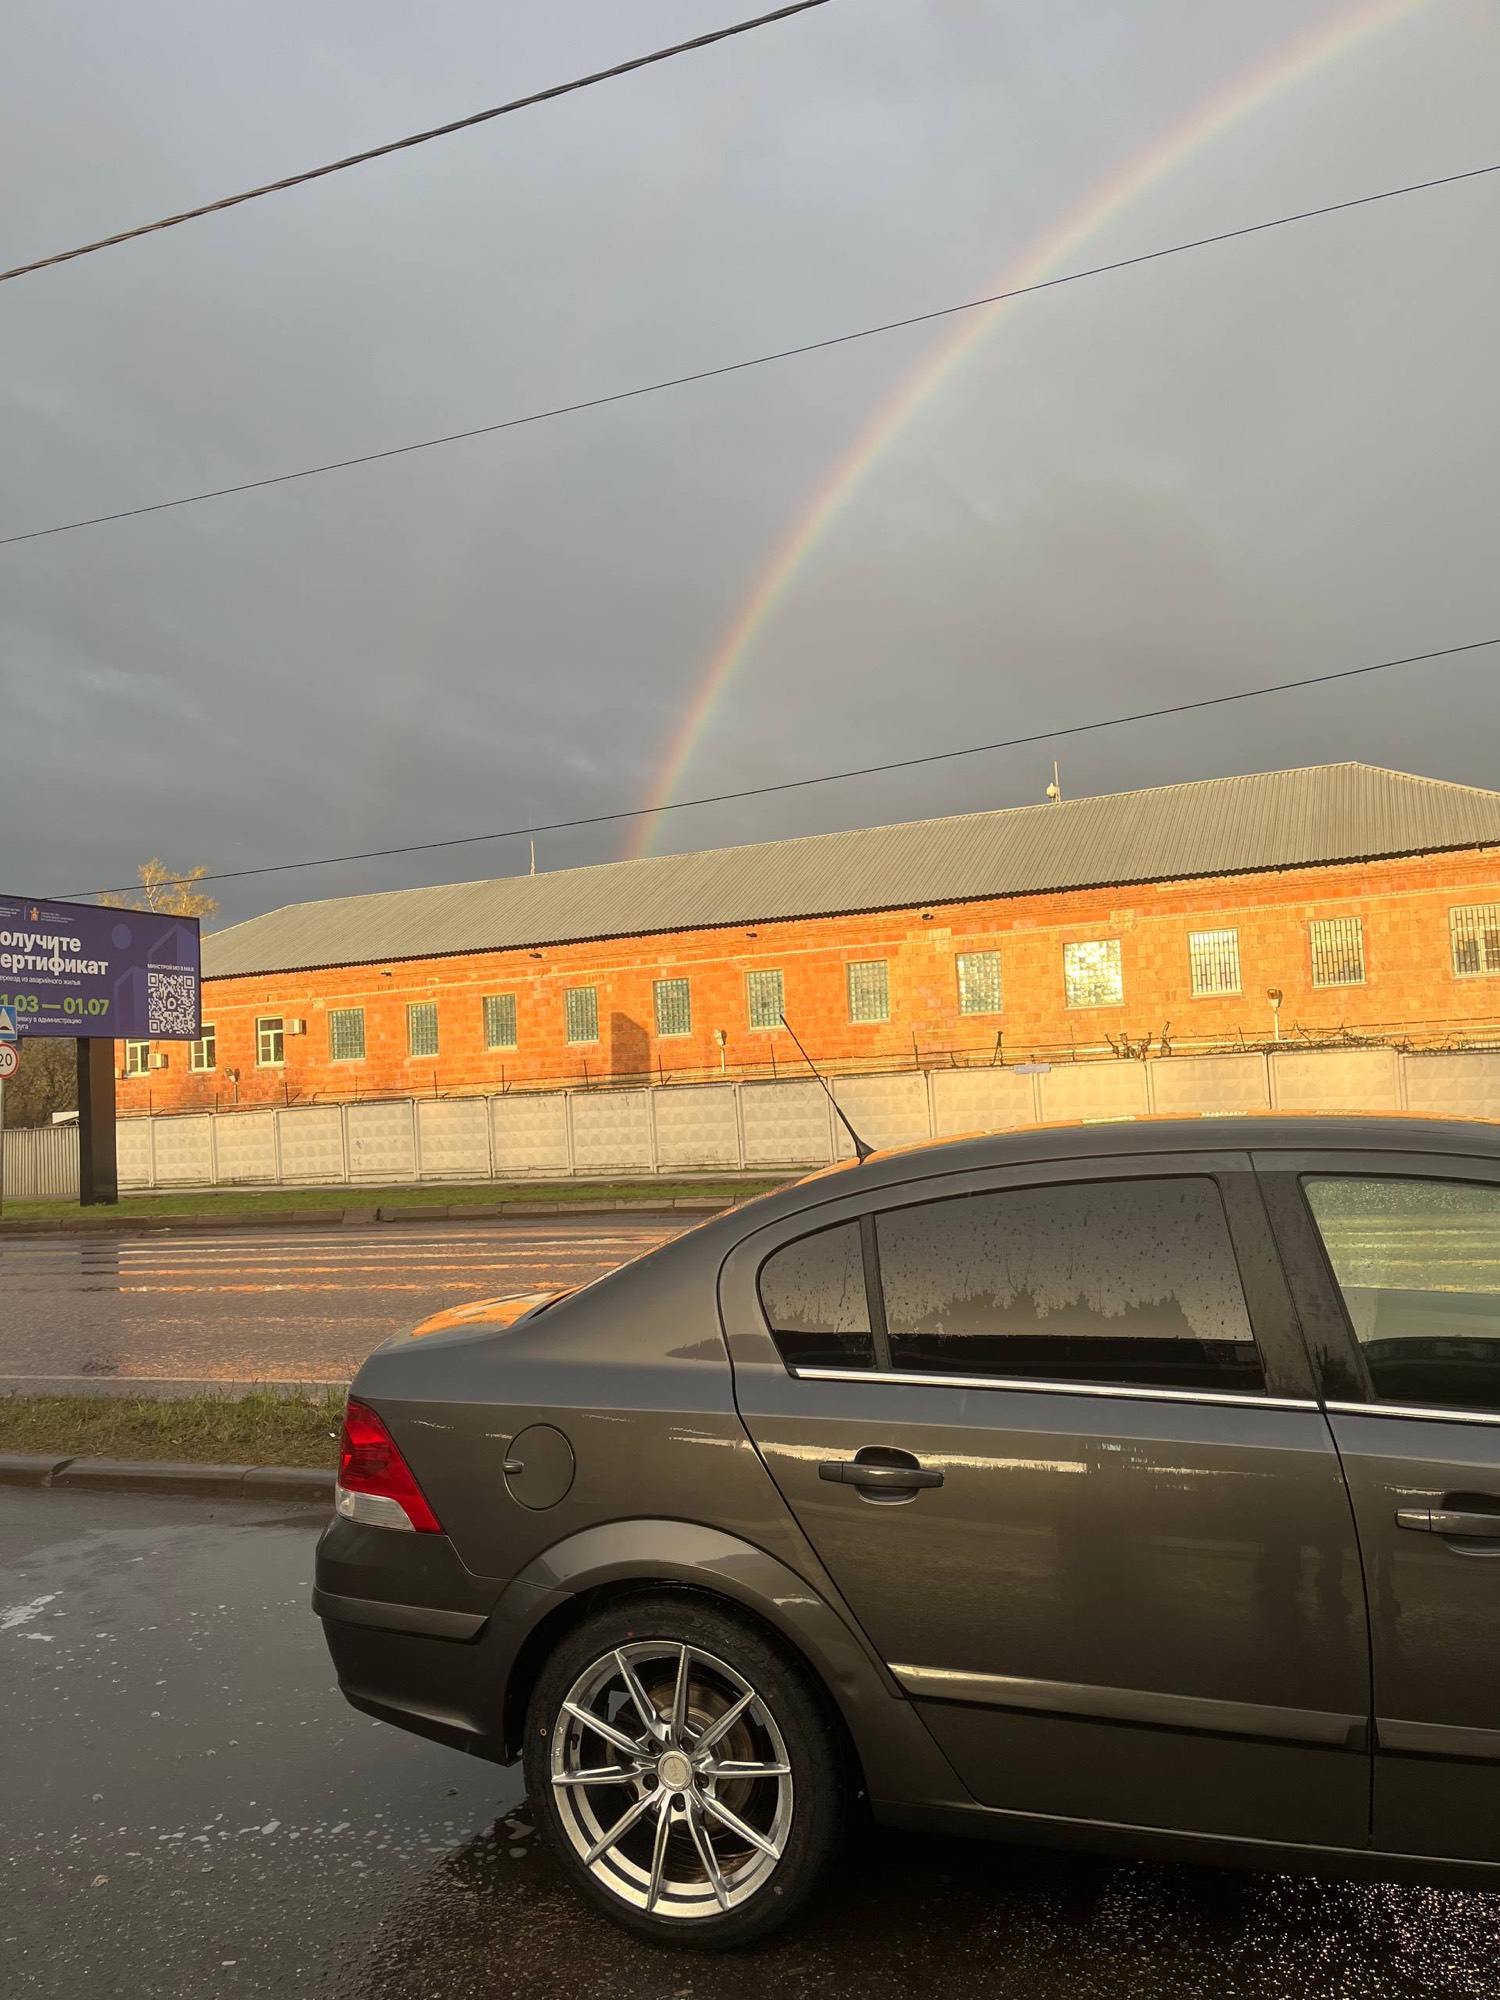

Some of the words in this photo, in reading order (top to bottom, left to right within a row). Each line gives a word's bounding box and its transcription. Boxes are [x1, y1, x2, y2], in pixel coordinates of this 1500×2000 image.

[0, 931, 81, 952] олучите
[0, 953, 109, 976] ертификат
[0, 994, 39, 1012] 103
[63, 997, 110, 1015] 01.07
